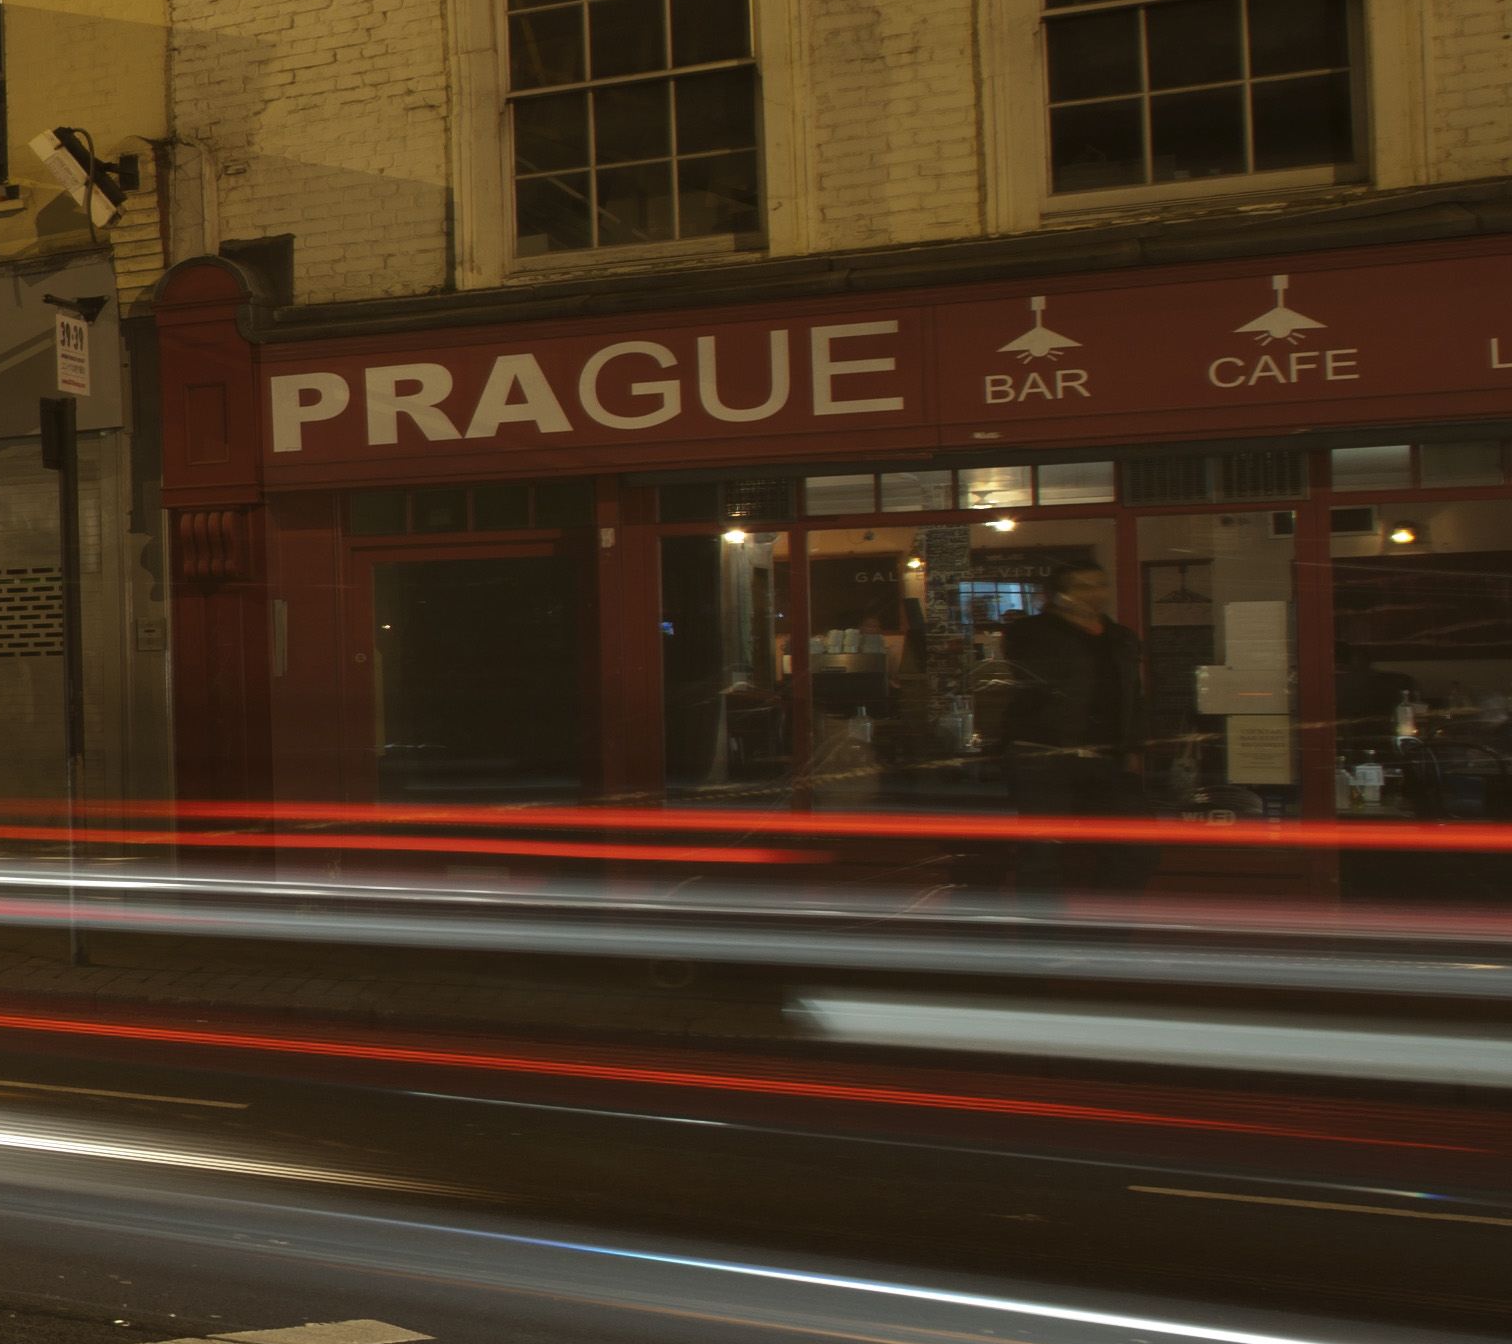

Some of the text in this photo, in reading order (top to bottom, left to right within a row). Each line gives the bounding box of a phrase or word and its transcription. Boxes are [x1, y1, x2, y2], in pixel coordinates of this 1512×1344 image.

[270, 319, 904, 454] PRAGUE
[985, 368, 1092, 404] BAR
[1209, 347, 1360, 389] CAFE
